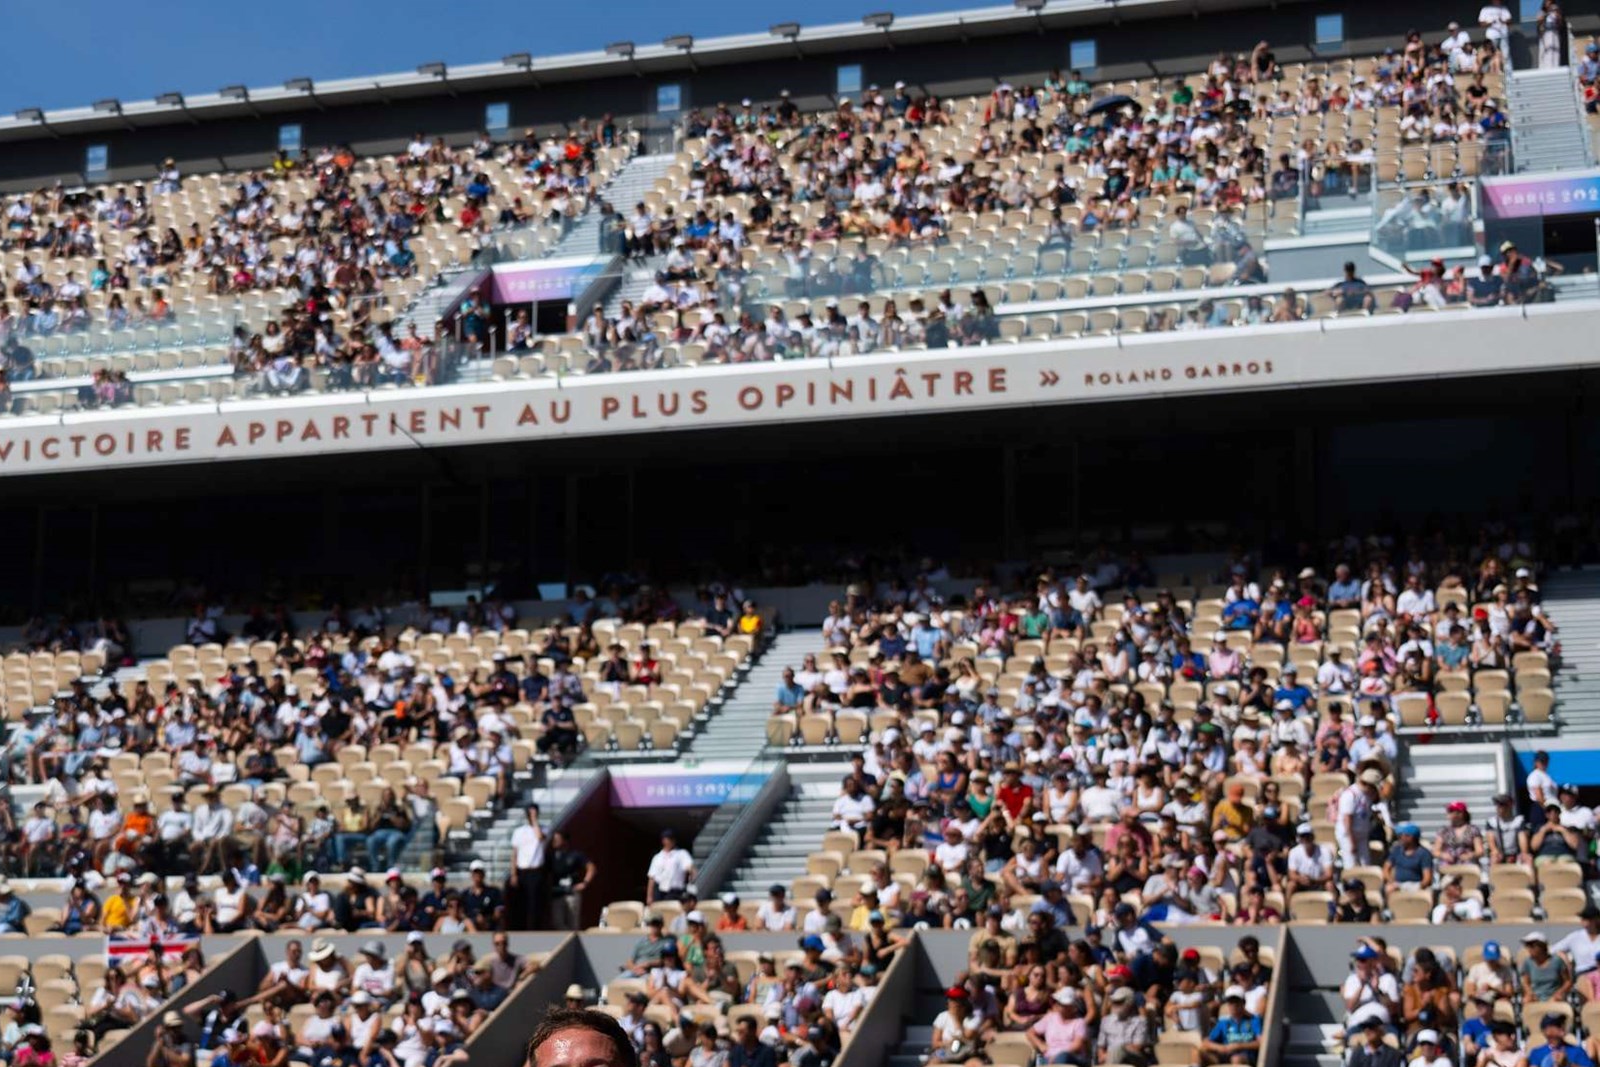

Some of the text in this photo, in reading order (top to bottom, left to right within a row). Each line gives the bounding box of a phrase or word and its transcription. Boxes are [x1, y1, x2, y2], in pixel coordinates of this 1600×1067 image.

[216, 404, 491, 447] APPARTIENT
[517, 400, 572, 427] AU
[601, 389, 709, 420] PLUS
[737, 367, 1007, 411] OPINIÂTRE
[1084, 367, 1173, 387] ROLAND
[1184, 360, 1274, 381] GARROS
